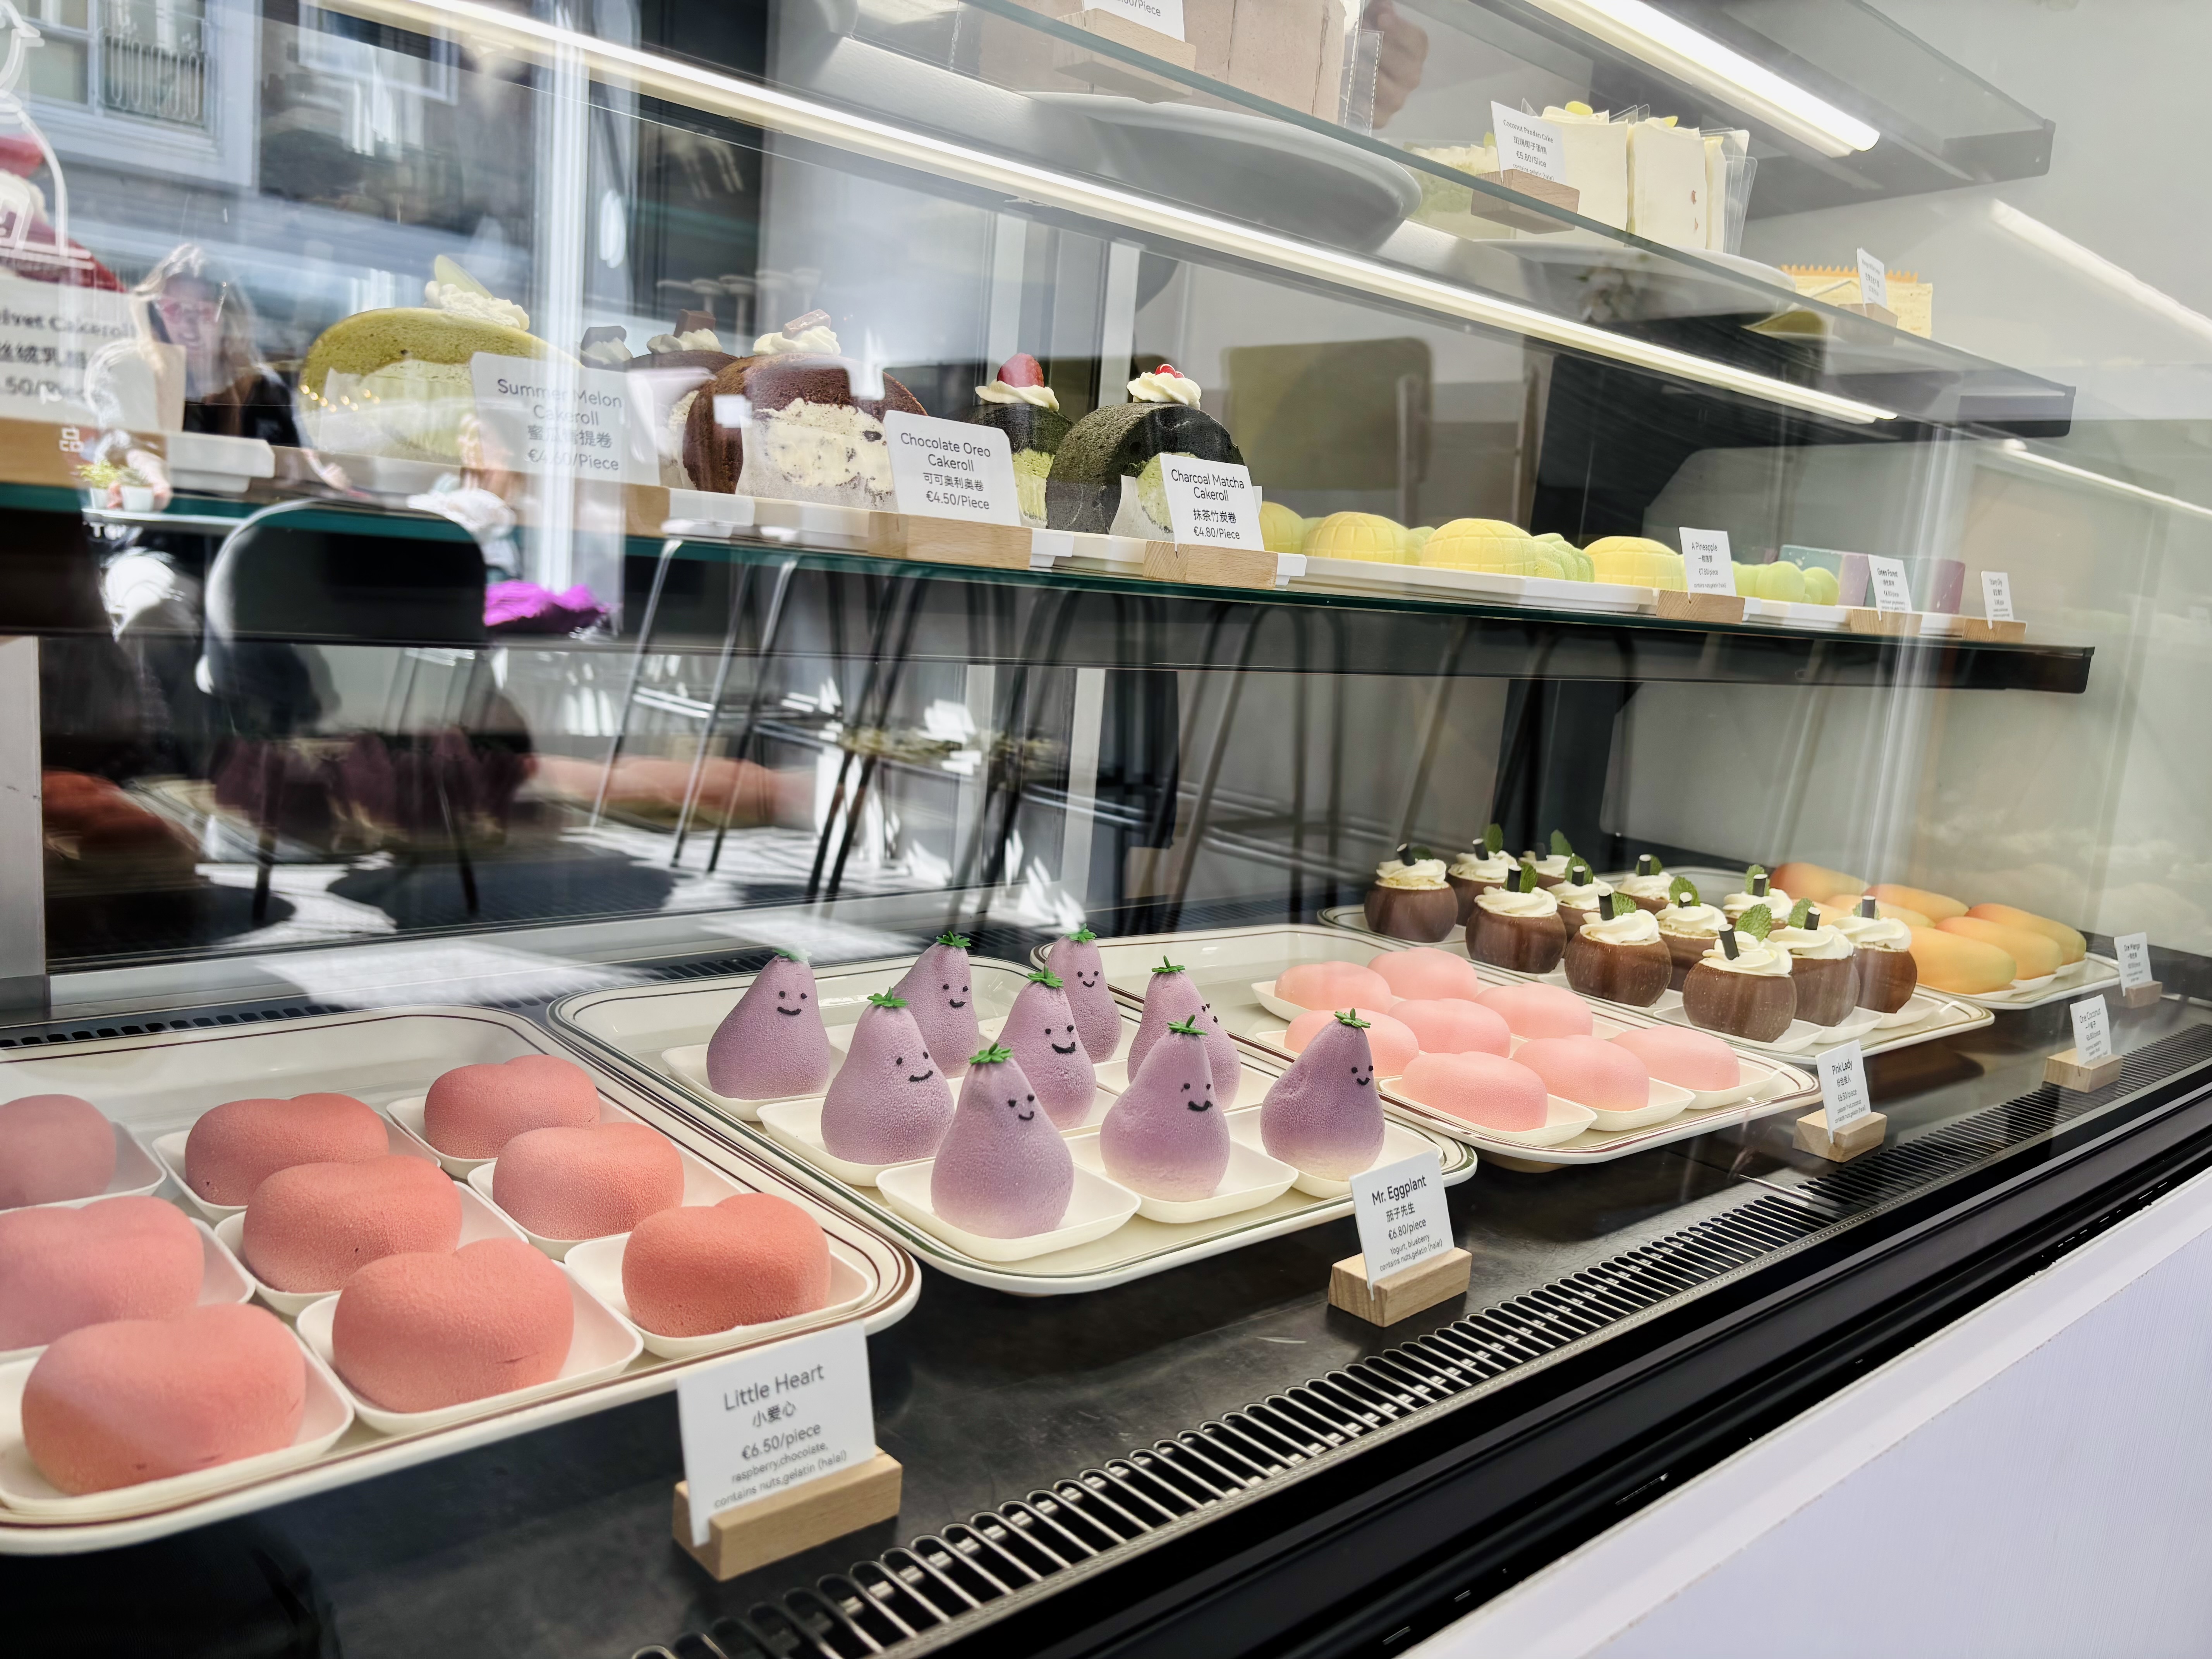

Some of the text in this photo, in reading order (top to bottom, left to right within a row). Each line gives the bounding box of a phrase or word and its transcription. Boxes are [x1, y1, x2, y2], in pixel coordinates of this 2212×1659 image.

[1503, 119, 1553, 143] Coconut Pandan Cake
[1516, 151, 1546, 167] €5.80/Slice
[497, 378, 622, 408] Summer Melon
[534, 404, 599, 426] Cakeroll
[900, 432, 991, 458] Chocolate Oreo
[928, 454, 974, 472] Cakeroll
[922, 472, 984, 491] 可可奥利奥卷
[1171, 469, 1245, 489] Charcoal Matcha
[926, 491, 990, 510] €4.50/Piece
[1193, 486, 1229, 502] Cakeroll
[1193, 508, 1237, 524] 抹茶竹炭卷
[1194, 526, 1240, 539] €4.80/Piece
[1692, 542, 1718, 553] A Pineapple
[1832, 1058, 1852, 1075] Pink Lady
[1372, 1175, 1427, 1205] Mr. Eggplant
[1386, 1201, 1415, 1223] 茄子先生
[1388, 1219, 1426, 1240] €6.80/piece
[1379, 1238, 1443, 1271] contains nuts,gelatin (halal)
[1390, 1233, 1430, 1255] Yogurt, blueberry
[724, 1364, 825, 1412] Little Heart
[752, 1400, 797, 1427] 小爱心
[742, 1424, 821, 1460] €6.50/piece
[714, 1485, 757, 1508] contains
[818, 1449, 847, 1470] (halal)
